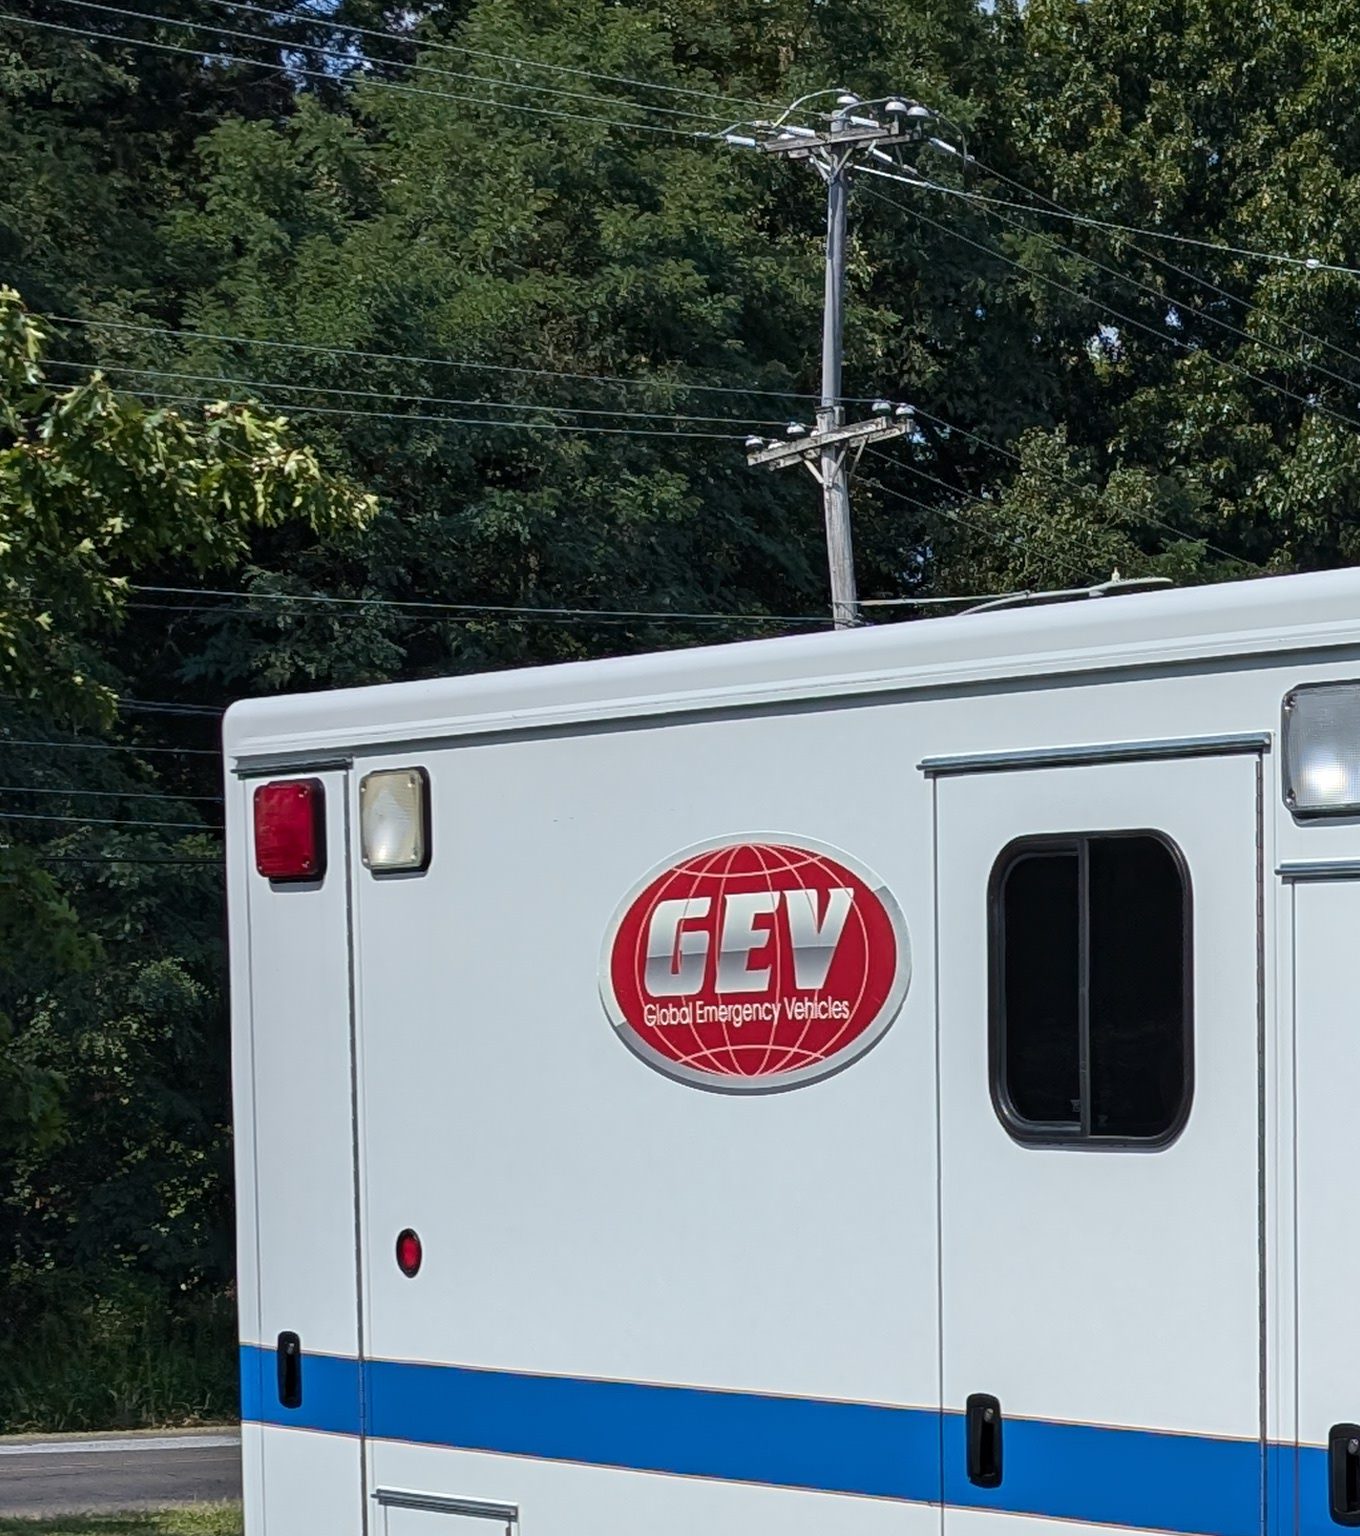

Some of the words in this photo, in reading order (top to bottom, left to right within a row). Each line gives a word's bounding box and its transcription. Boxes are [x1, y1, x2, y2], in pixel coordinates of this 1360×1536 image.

[644, 887, 854, 998] GEV
[643, 1002, 692, 1026] Global
[696, 1001, 782, 1028] Emergency
[784, 995, 850, 1020] Vehicles
